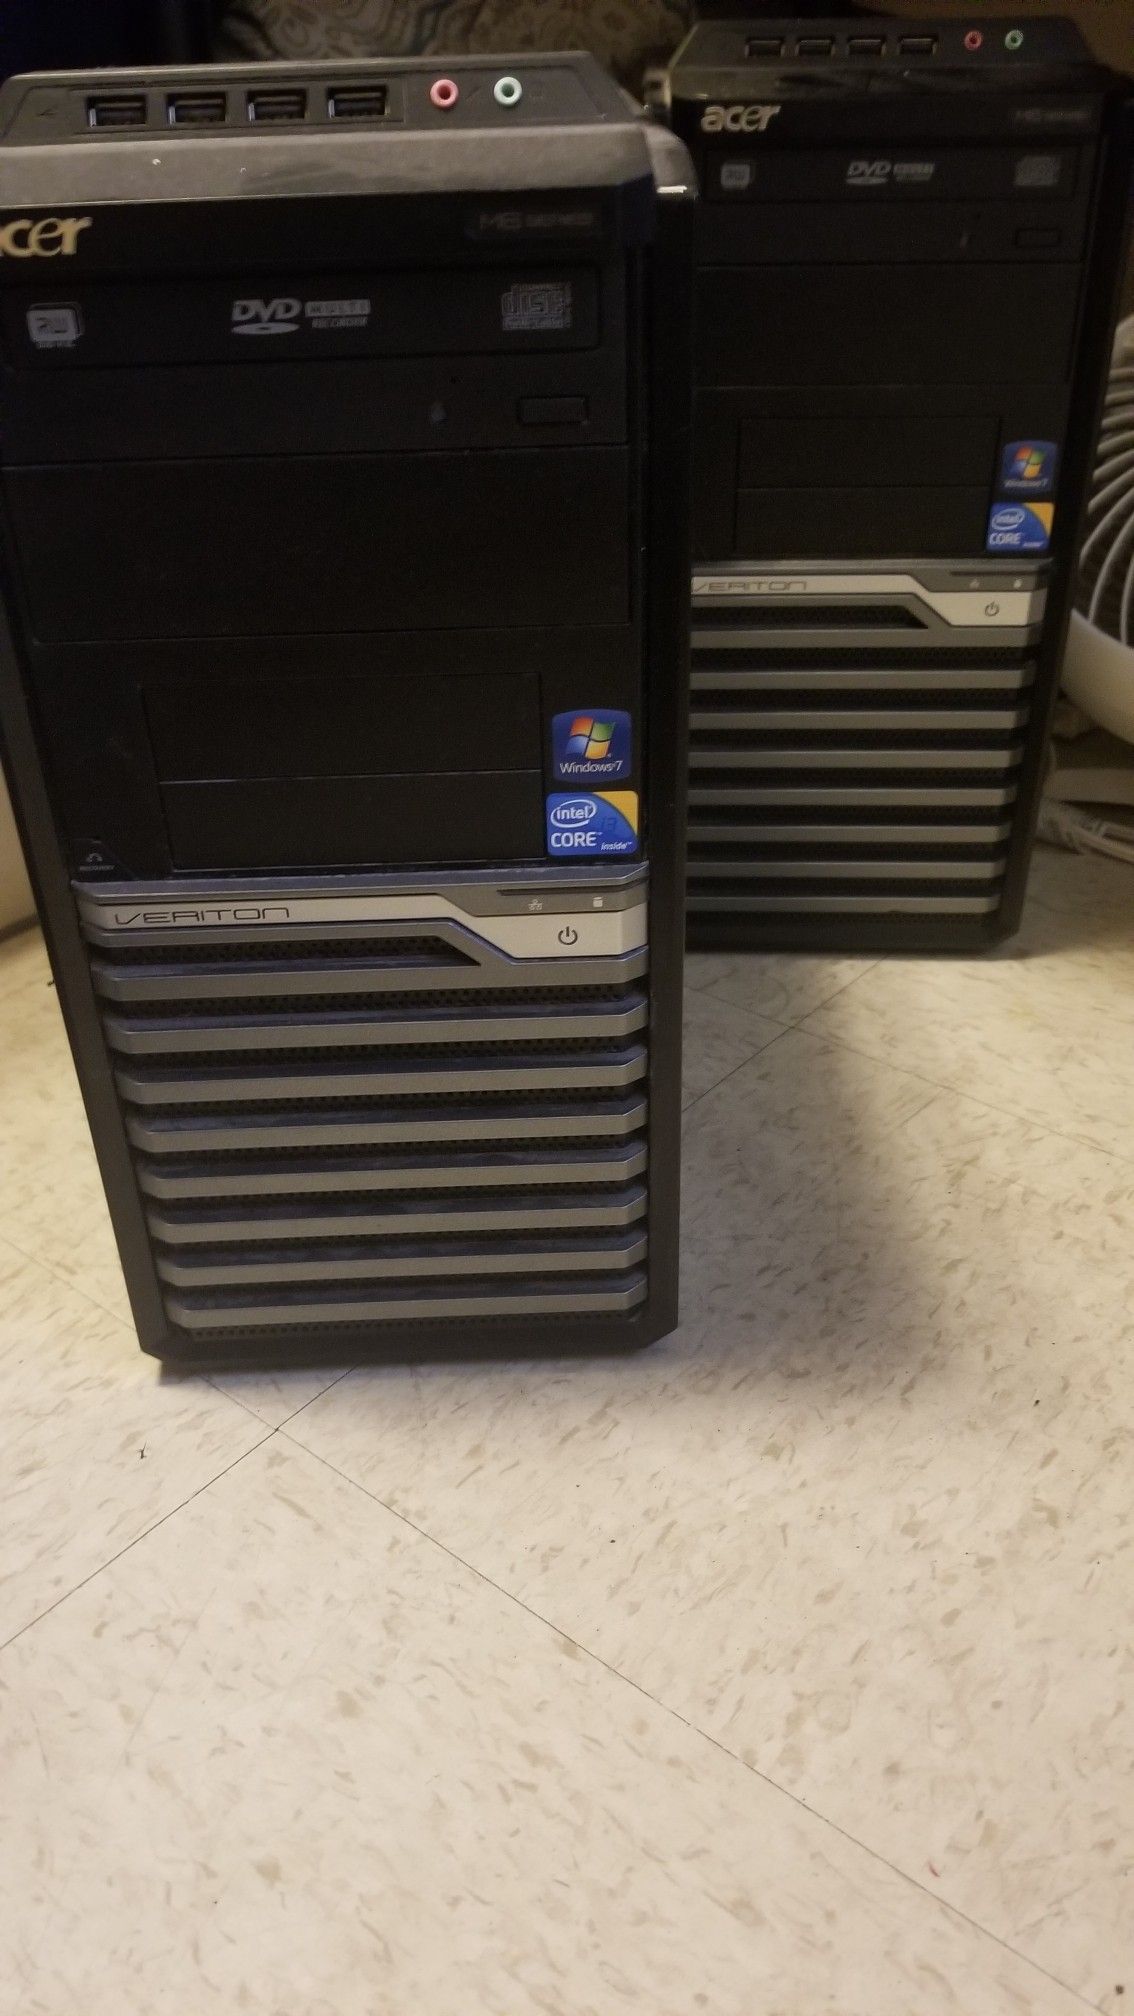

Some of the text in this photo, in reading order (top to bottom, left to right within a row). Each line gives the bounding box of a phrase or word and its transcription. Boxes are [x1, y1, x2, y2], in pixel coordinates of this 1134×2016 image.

[701, 105, 781, 132] acer
[0, 216, 93, 258] cer
[231, 298, 302, 322] DVD
[556, 805, 589, 820] intel
[550, 831, 597, 848] CORE
[114, 907, 290, 926] VERITON
